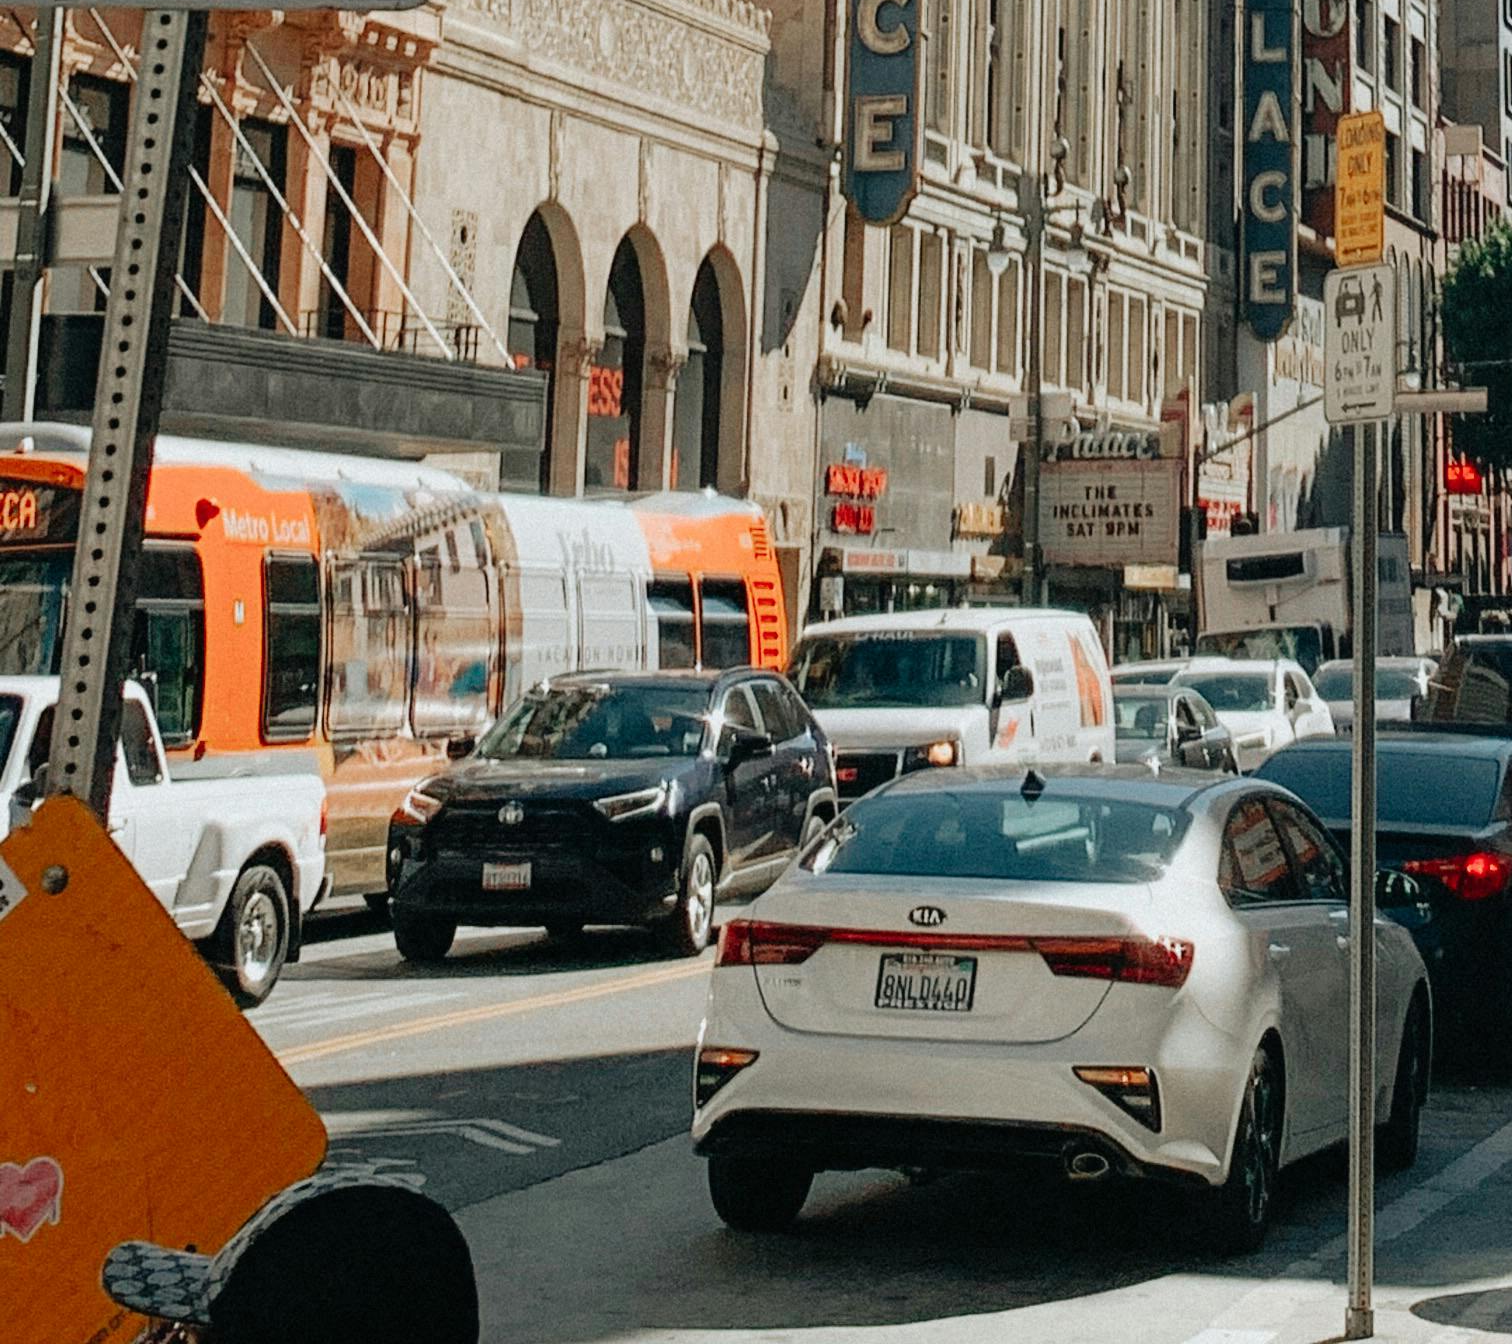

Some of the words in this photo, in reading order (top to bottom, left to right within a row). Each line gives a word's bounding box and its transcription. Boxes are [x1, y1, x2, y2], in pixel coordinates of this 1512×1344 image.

[1341, 327, 1374, 354] ONLY
[1084, 485, 1117, 501] THE
[221, 509, 269, 543] Metro
[271, 511, 311, 545] Local
[1066, 522, 1095, 537] SAT
[910, 907, 943, 925] KIA
